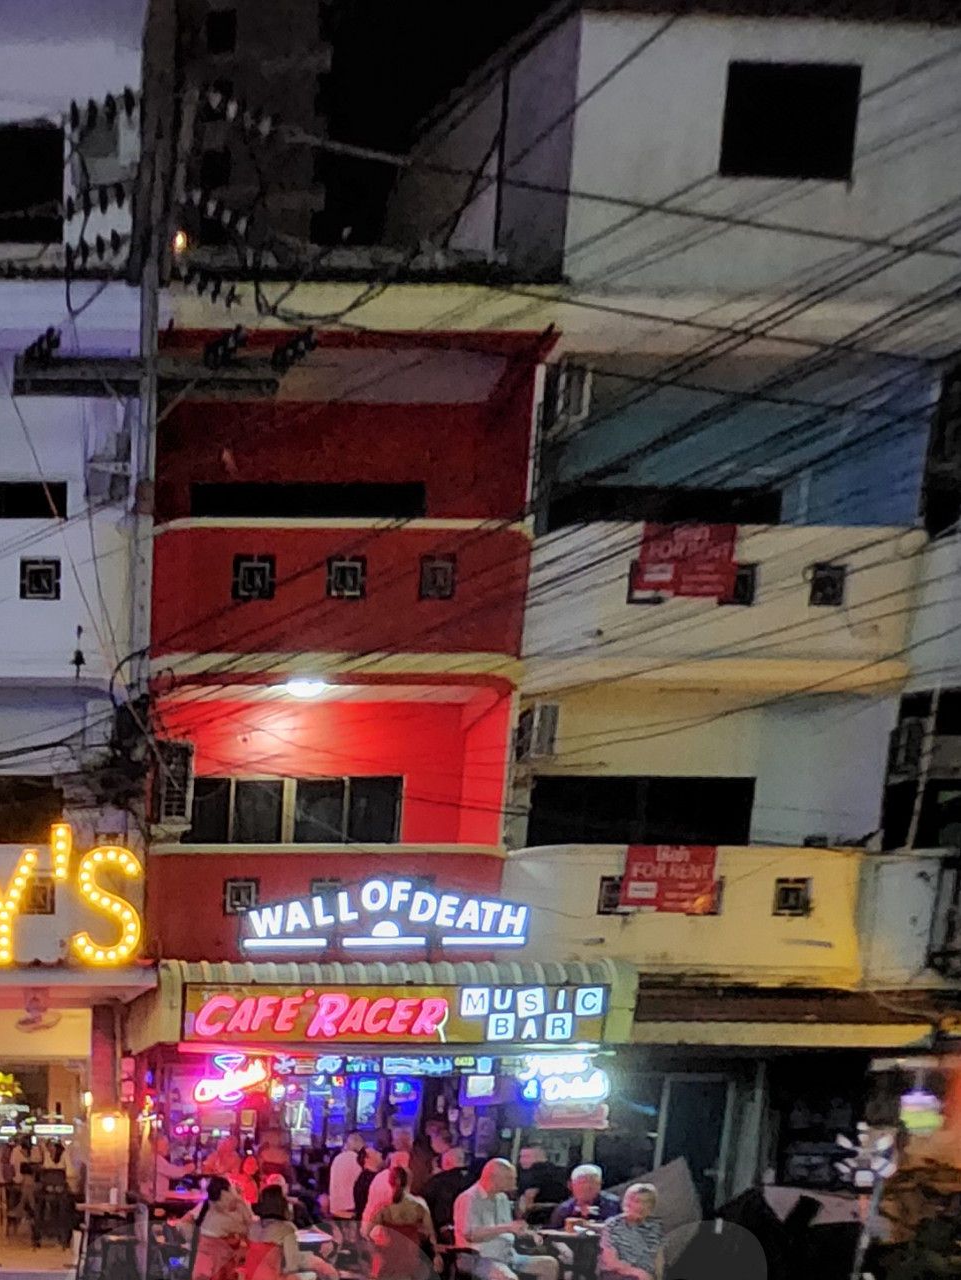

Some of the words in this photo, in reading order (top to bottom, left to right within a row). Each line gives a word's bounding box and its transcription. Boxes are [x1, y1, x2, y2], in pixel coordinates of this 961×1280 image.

[631, 861, 667, 879] FOR
[669, 863, 713, 880] RENT
[248, 890, 359, 938] WALL
[360, 879, 413, 913] OF
[408, 890, 528, 936] DEATH
[306, 992, 449, 1040] RACER
[462, 986, 604, 1018] MUSIC
[487, 1012, 573, 1041] BAR
